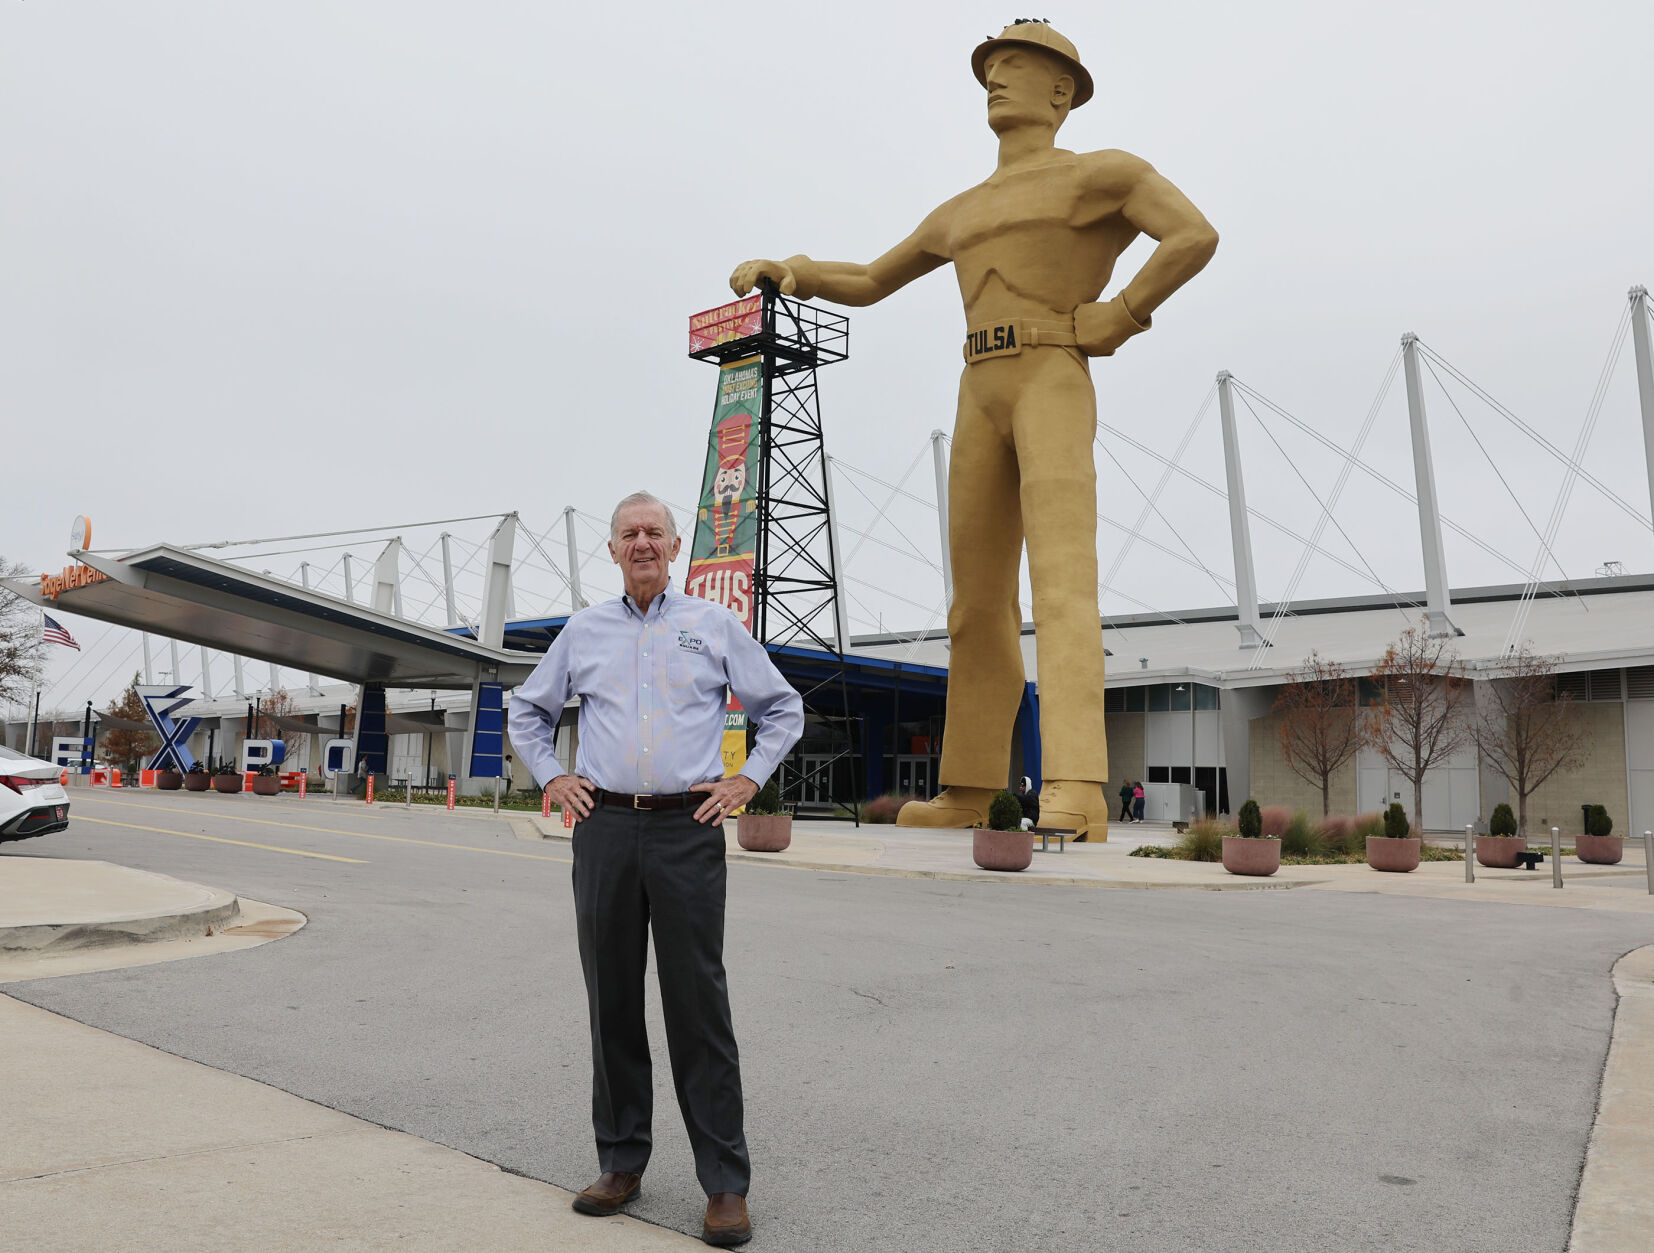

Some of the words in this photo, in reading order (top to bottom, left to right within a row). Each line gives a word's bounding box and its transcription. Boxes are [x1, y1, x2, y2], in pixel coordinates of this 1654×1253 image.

[967, 325, 1016, 357] TULSA
[740, 388, 758, 401] EVENT
[689, 569, 749, 622] THIS
